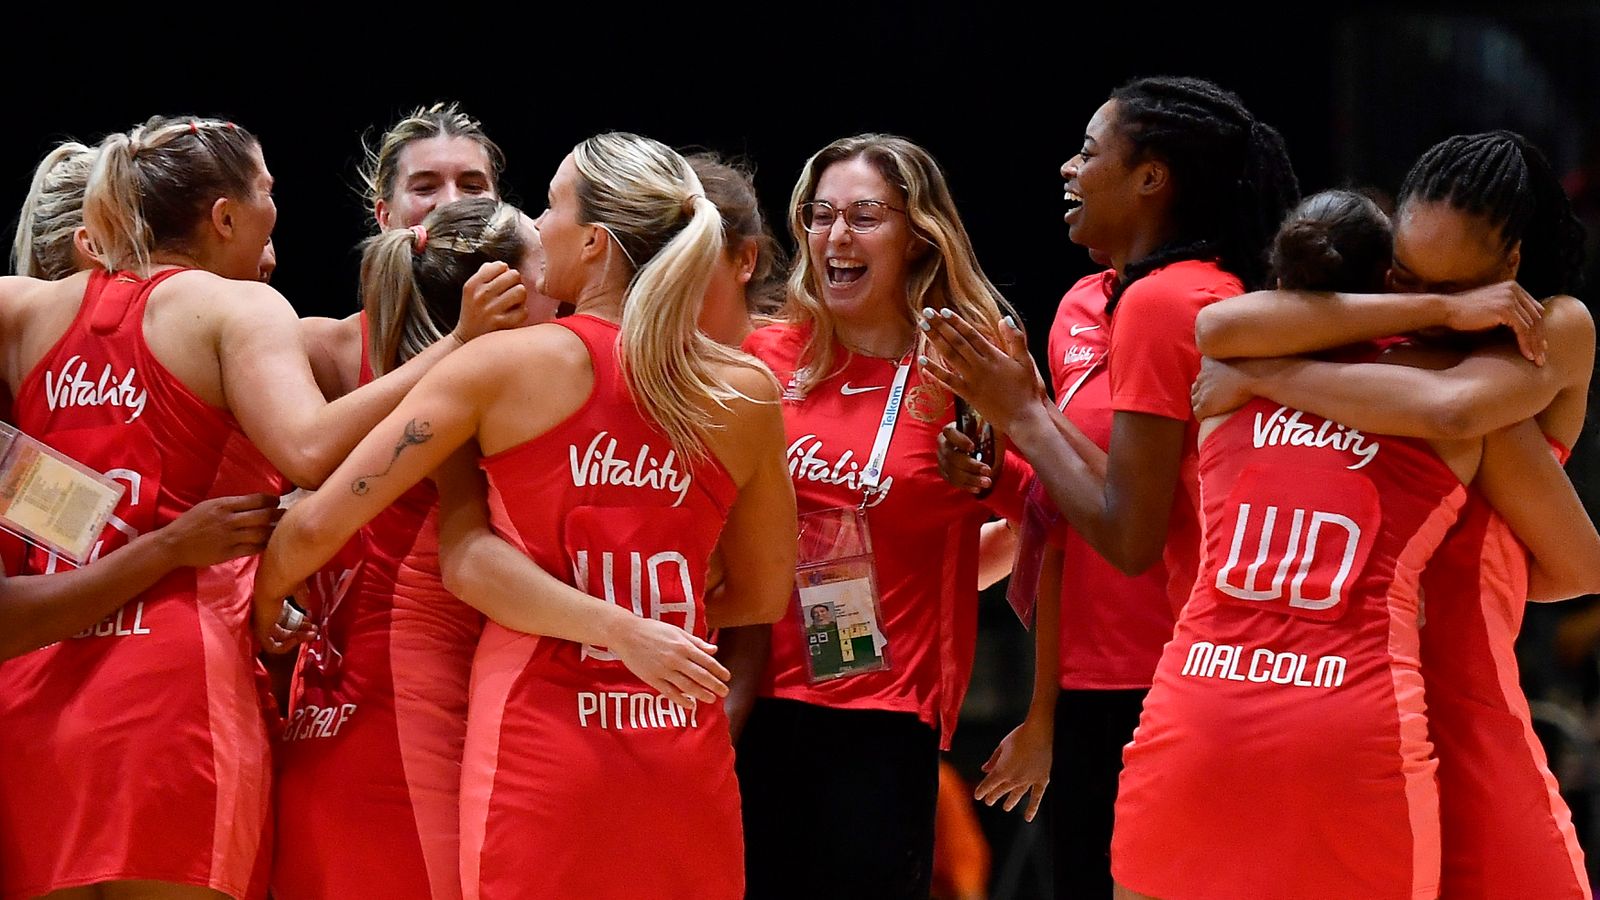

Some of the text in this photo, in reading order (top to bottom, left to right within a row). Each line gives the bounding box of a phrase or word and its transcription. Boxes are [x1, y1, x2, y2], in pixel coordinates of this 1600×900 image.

[45, 355, 147, 424] Vitality
[881, 385, 902, 428] Telkom
[569, 431, 691, 508] Vitality
[786, 434, 893, 507] italiy
[1253, 406, 1380, 470] Vitality
[1215, 503, 1361, 611] WD
[1182, 641, 1347, 688] MALCOLM
[577, 692, 698, 730] PITMAN
